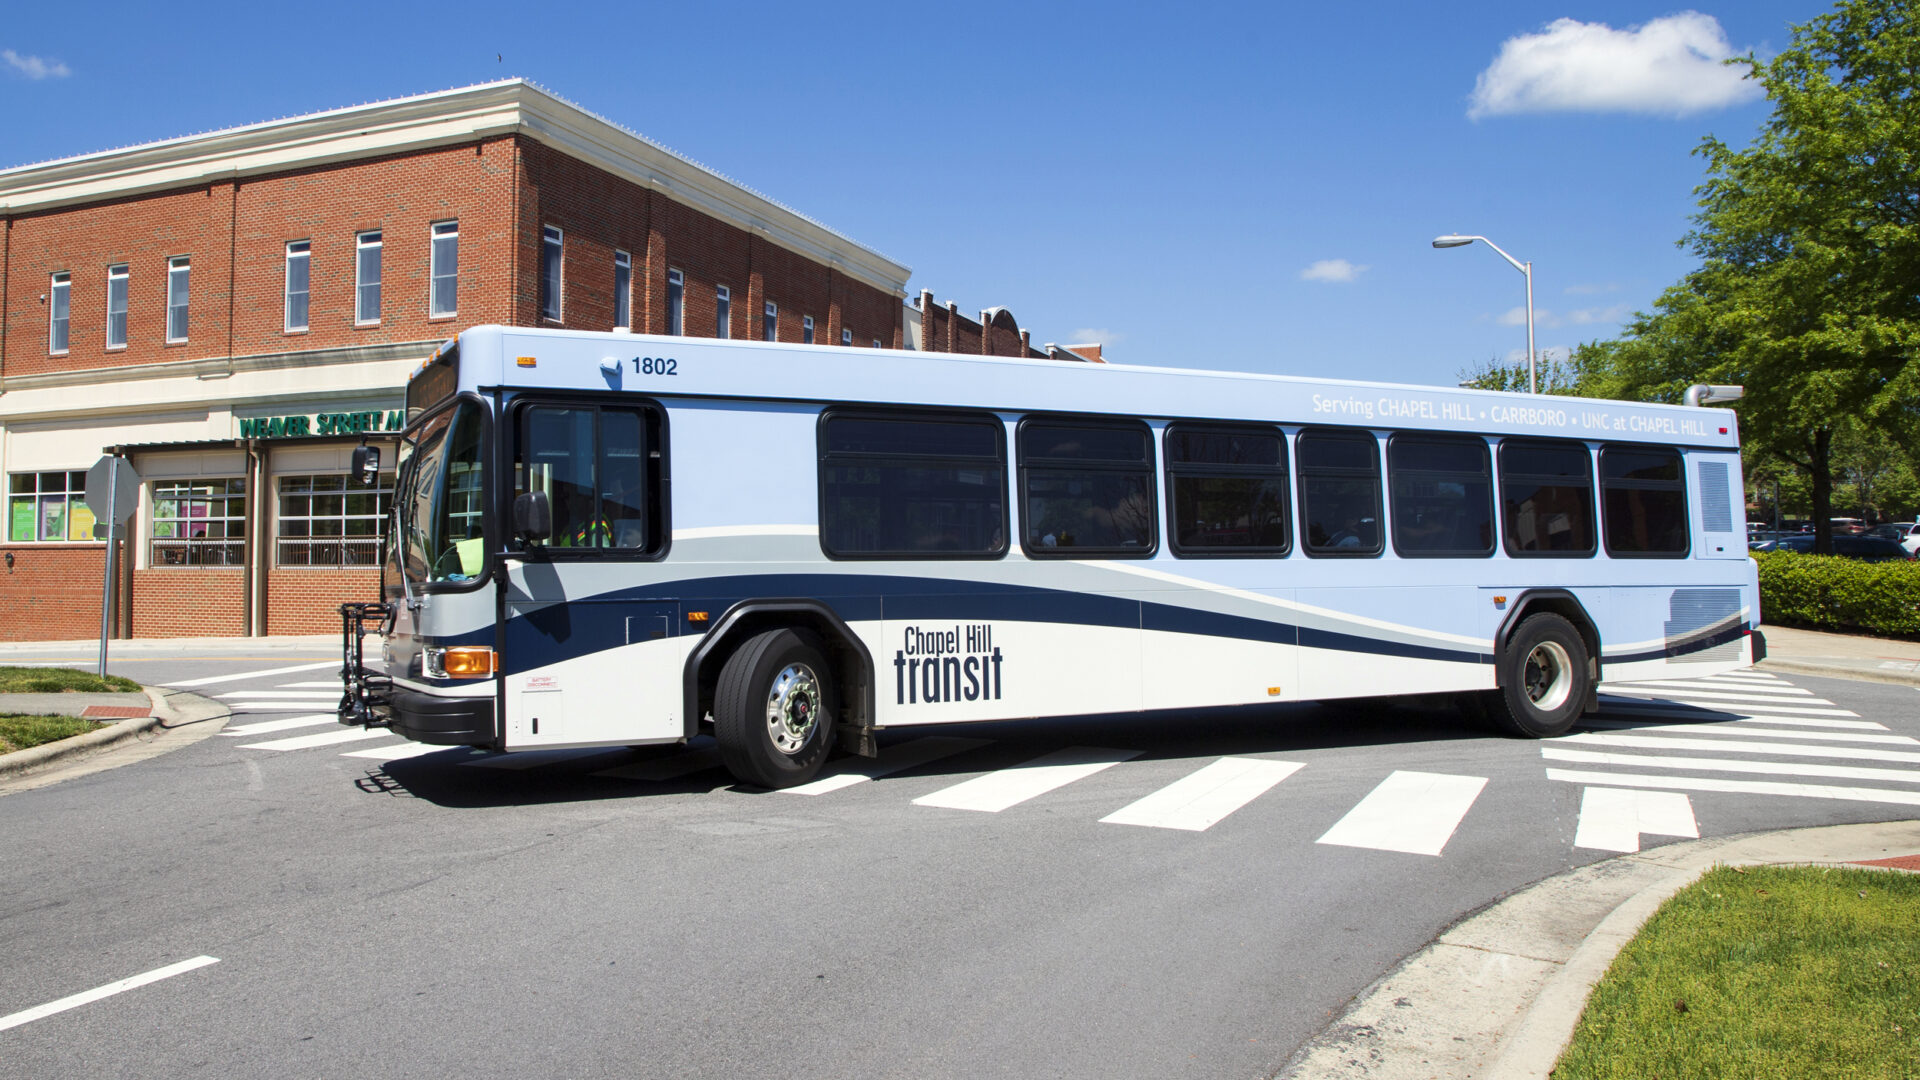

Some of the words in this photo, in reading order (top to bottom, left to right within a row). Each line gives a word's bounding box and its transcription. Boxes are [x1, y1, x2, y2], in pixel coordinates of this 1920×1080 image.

[631, 356, 678, 376] 1802
[239, 415, 312, 438] WEAVER
[316, 410, 385, 434] STREET
[1312, 393, 1373, 420] Serving
[1378, 398, 1439, 419] CHAPEL
[1442, 402, 1476, 422] HILL
[1490, 405, 1567, 427] CARRBORO
[1581, 412, 1610, 430] UNC
[1613, 417, 1626, 431] at
[1629, 415, 1679, 435] CHAPEL
[1681, 419, 1708, 437] HILL
[904, 624, 960, 658] Chapel
[966, 624, 992, 653] Hill
[893, 646, 1004, 705] transit
